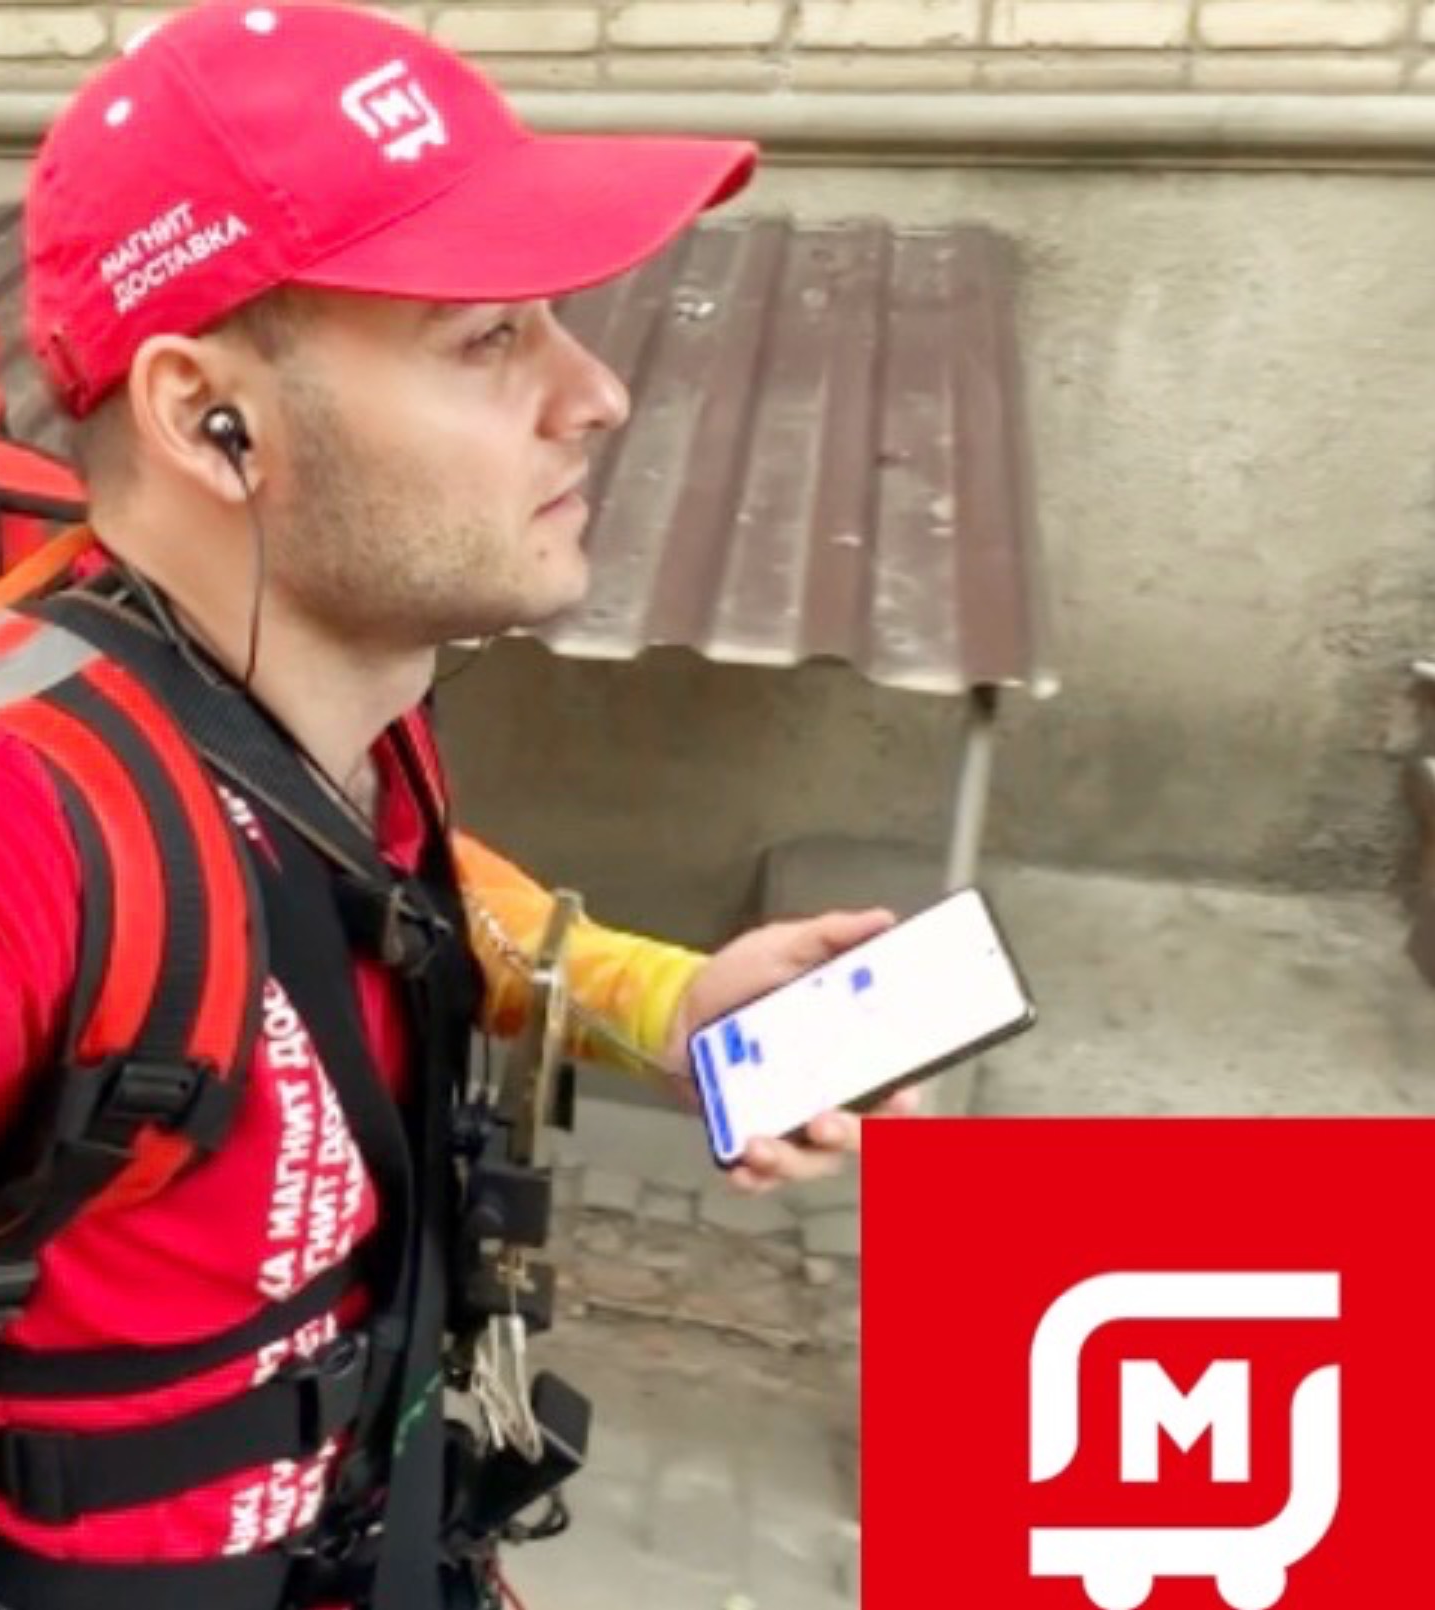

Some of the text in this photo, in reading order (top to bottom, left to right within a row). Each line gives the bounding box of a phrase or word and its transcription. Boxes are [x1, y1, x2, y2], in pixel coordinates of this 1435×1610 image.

[101, 203, 193, 283] МАГНИТ
[113, 213, 251, 315] ДОСТАВКА
[268, 1078, 315, 1240] МАГНИТ
